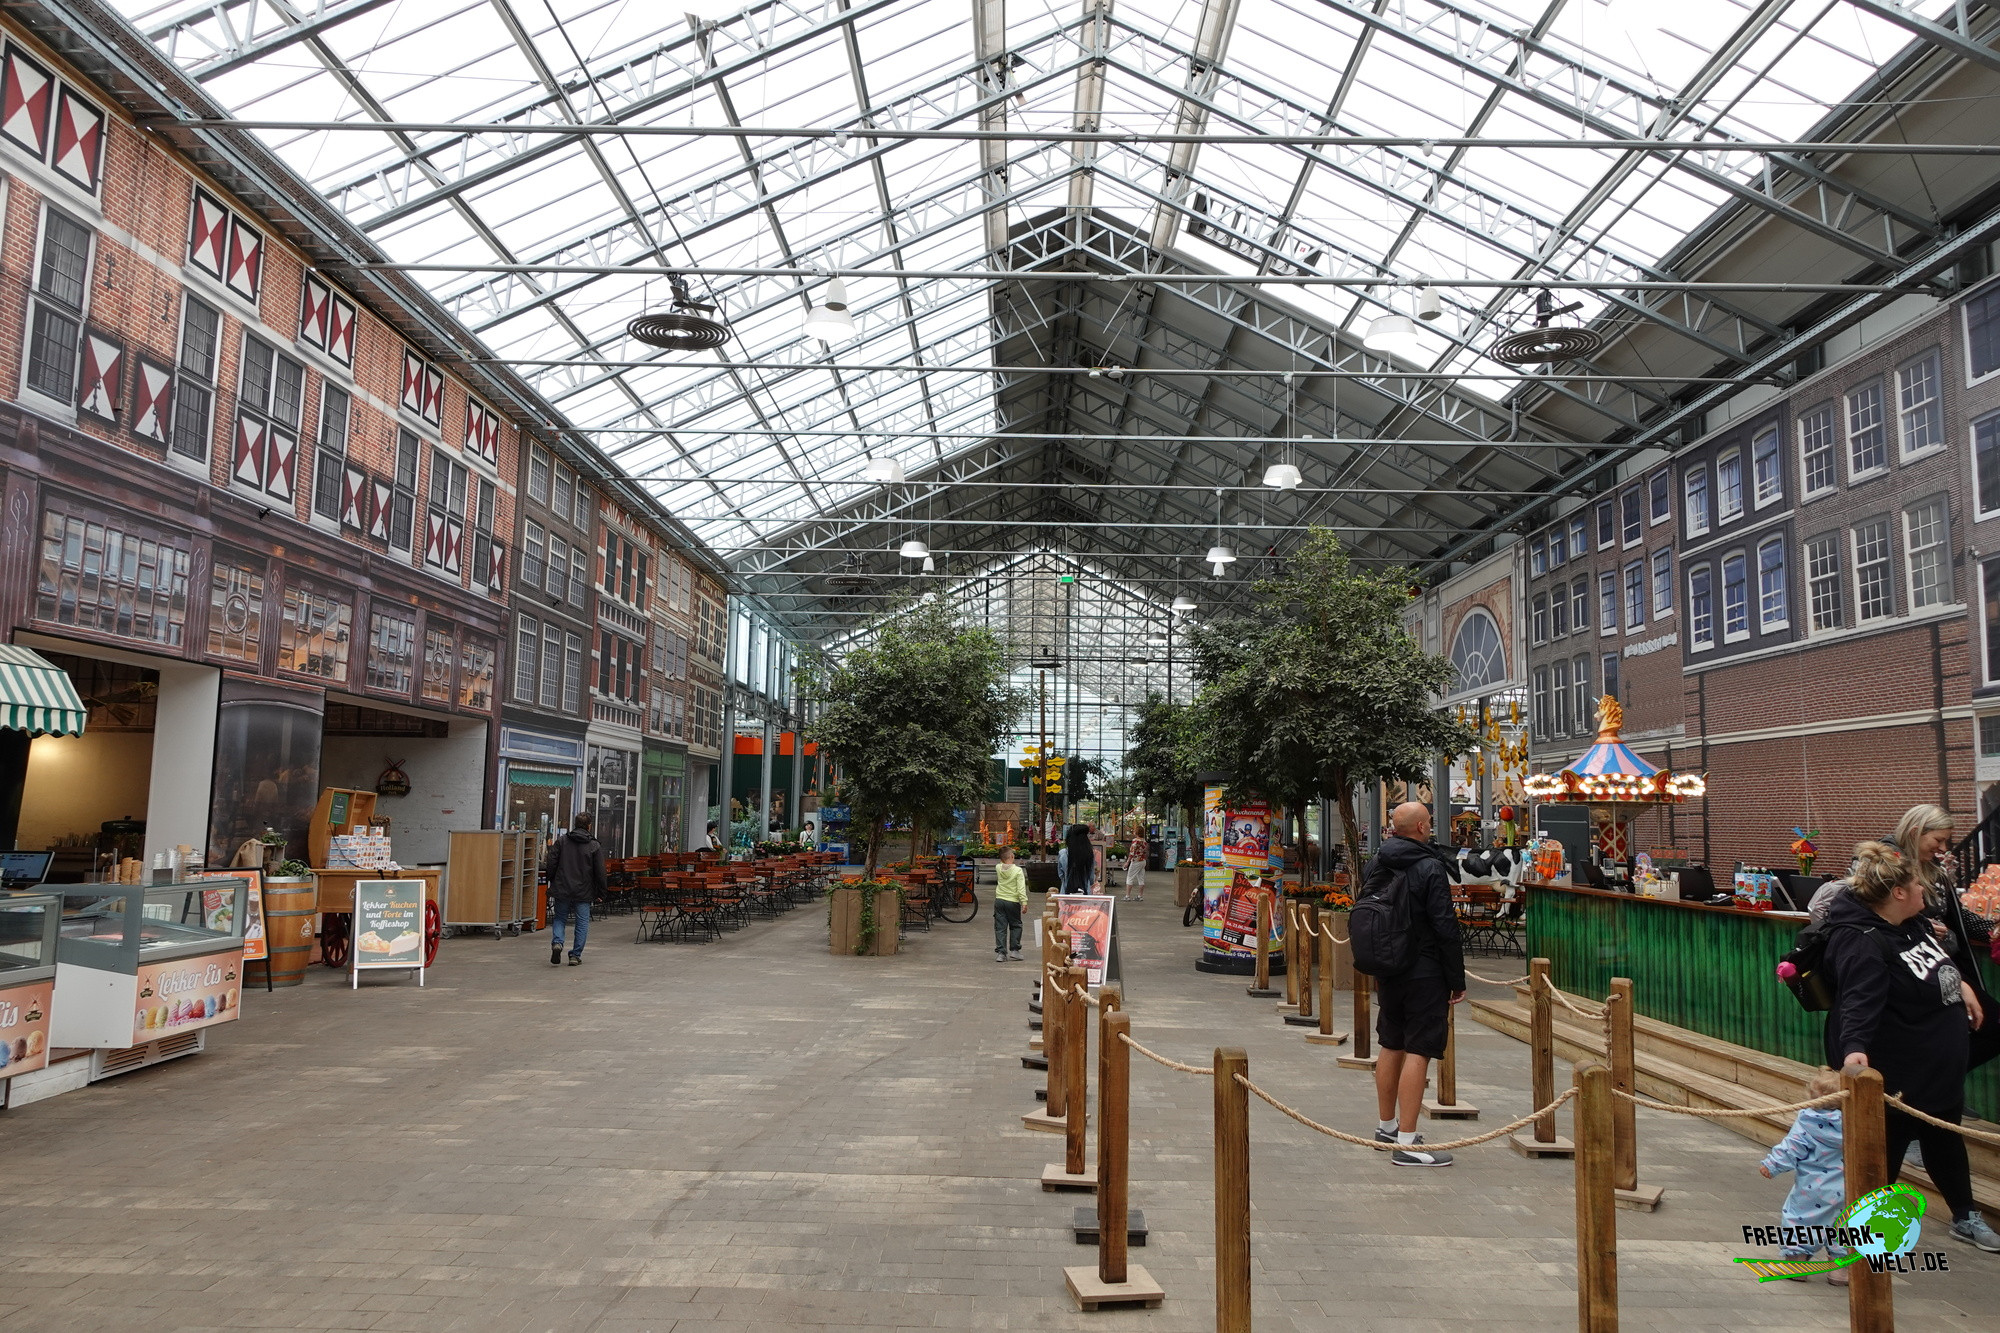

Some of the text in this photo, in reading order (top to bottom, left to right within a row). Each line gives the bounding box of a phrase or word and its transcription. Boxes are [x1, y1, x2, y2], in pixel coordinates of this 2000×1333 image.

[1234, 886, 1258, 900] Aben
[362, 900, 418, 911] Lekker Kuchen
[366, 910, 382, 919] und
[382, 910, 402, 918] Torte
[370, 920, 410, 930] Koffieshop
[158, 964, 222, 1002] Lekker Eis
